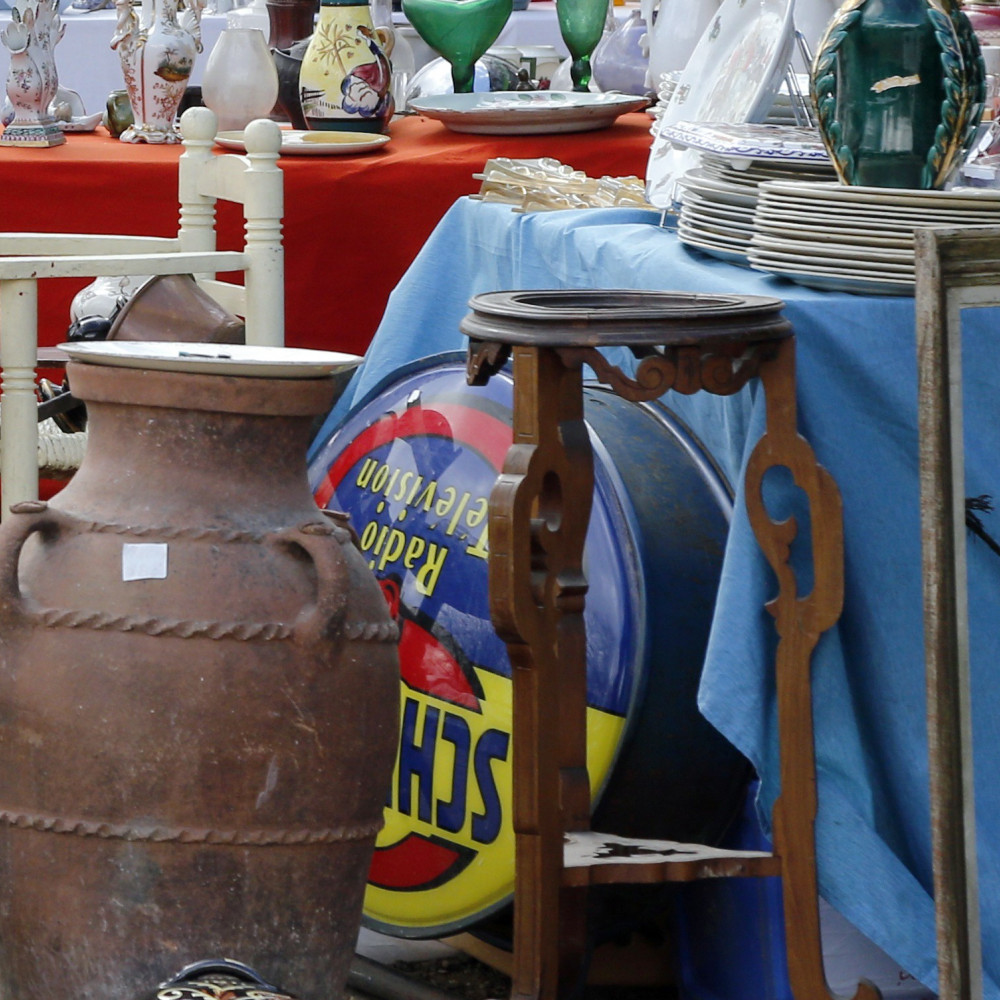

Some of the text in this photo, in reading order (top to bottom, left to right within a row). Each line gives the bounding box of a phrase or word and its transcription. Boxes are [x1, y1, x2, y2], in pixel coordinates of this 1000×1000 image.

[356, 458, 489, 559] Télévision
[360, 521, 448, 597] Radio
[384, 696, 511, 845] SCH
